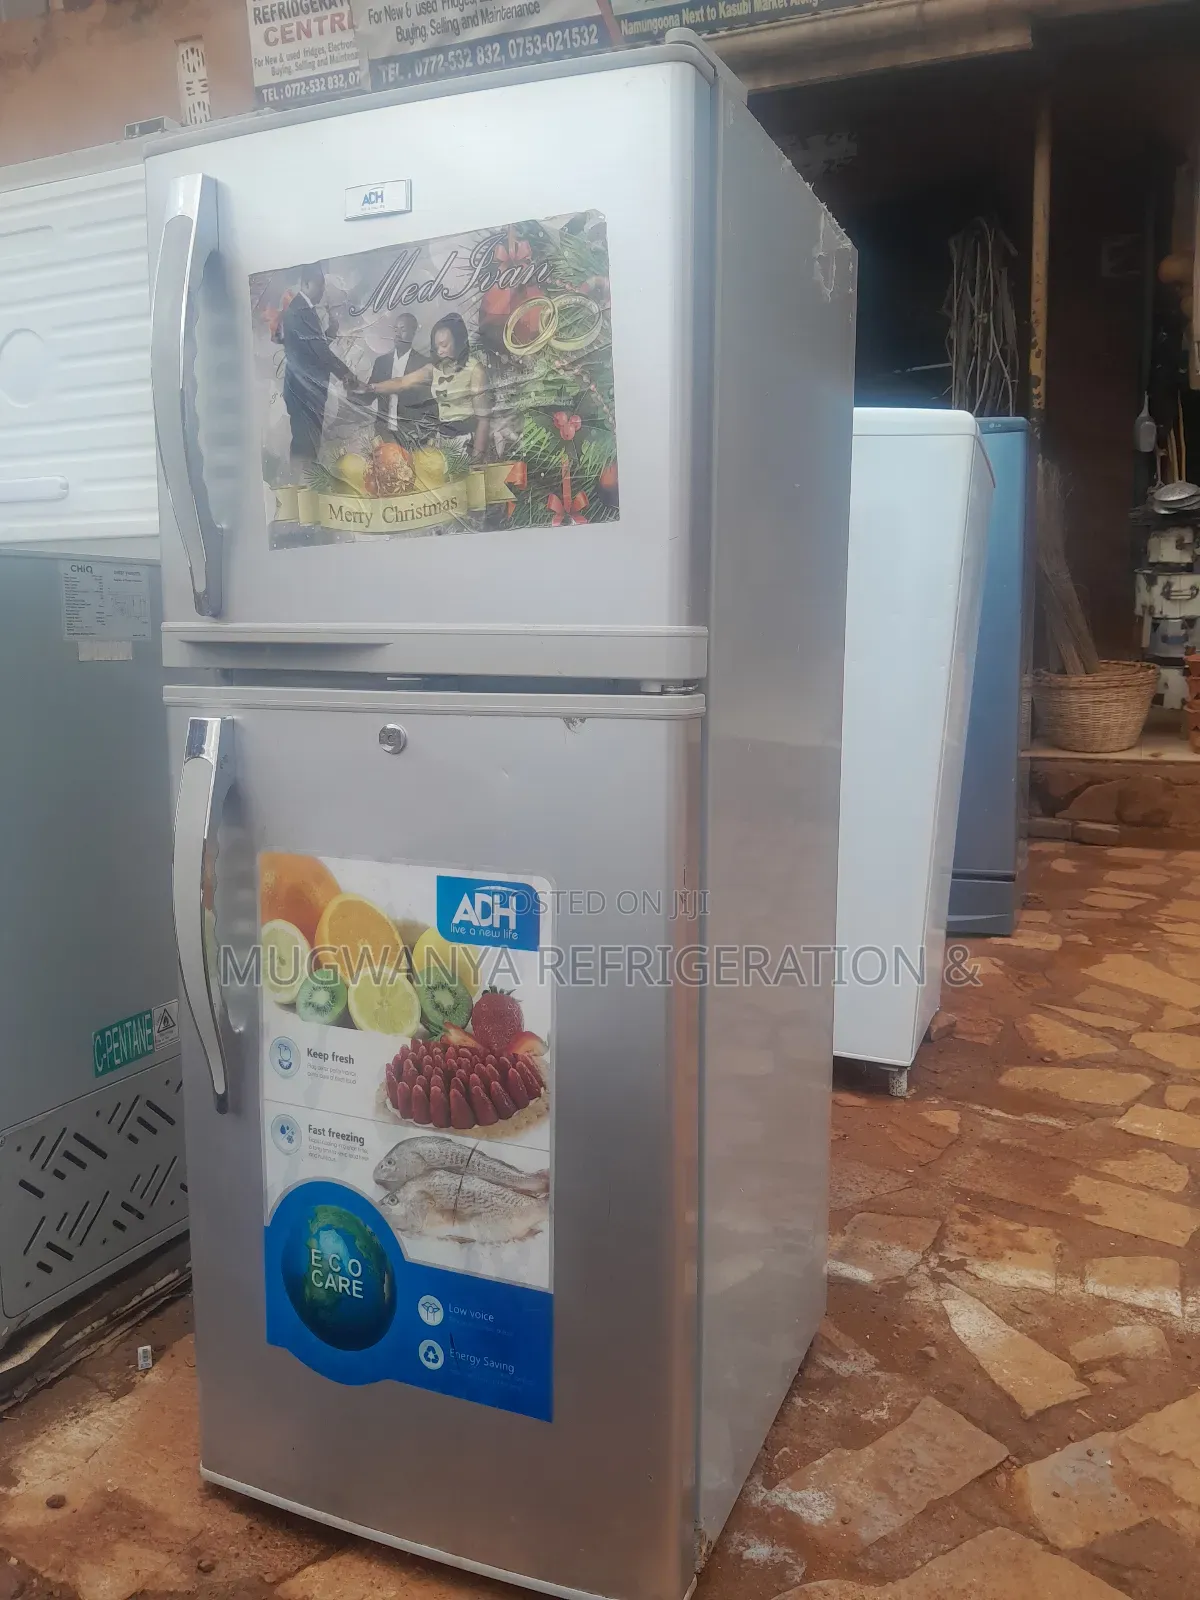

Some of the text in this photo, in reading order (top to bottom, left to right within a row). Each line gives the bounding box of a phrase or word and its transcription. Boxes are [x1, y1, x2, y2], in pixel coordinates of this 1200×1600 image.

[368, 8, 383, 25] For
[384, 5, 404, 21] New
[416, 0, 438, 16] used
[395, 0, 541, 45] Buying, Selling and Maintenance
[620, 14, 680, 36] Namungoona
[681, 5, 705, 25] Next
[706, 5, 717, 21] to
[718, 0, 752, 19] Kasubi
[253, 57, 263, 69] For
[264, 54, 278, 66] New
[317, 55, 328, 67] and
[414, 48, 474, 78] 0772-532
[507, 24, 599, 59] 0753-021532
[284, 77, 326, 99] 0772-532
[350, 231, 557, 317] Med Ivan
[328, 496, 458, 528] Merry Christmas
[452, 886, 518, 931] ADH
[450, 922, 519, 940] live a new life
[94, 1013, 153, 1072] C-PENTANE
[306, 1047, 355, 1065] Keep fresh
[308, 1124, 365, 1146] Fast freezing
[310, 1248, 362, 1278] ECO
[311, 1269, 364, 1299] CARE
[449, 1303, 495, 1323] Low voice
[450, 1348, 515, 1375] Energy Saving
